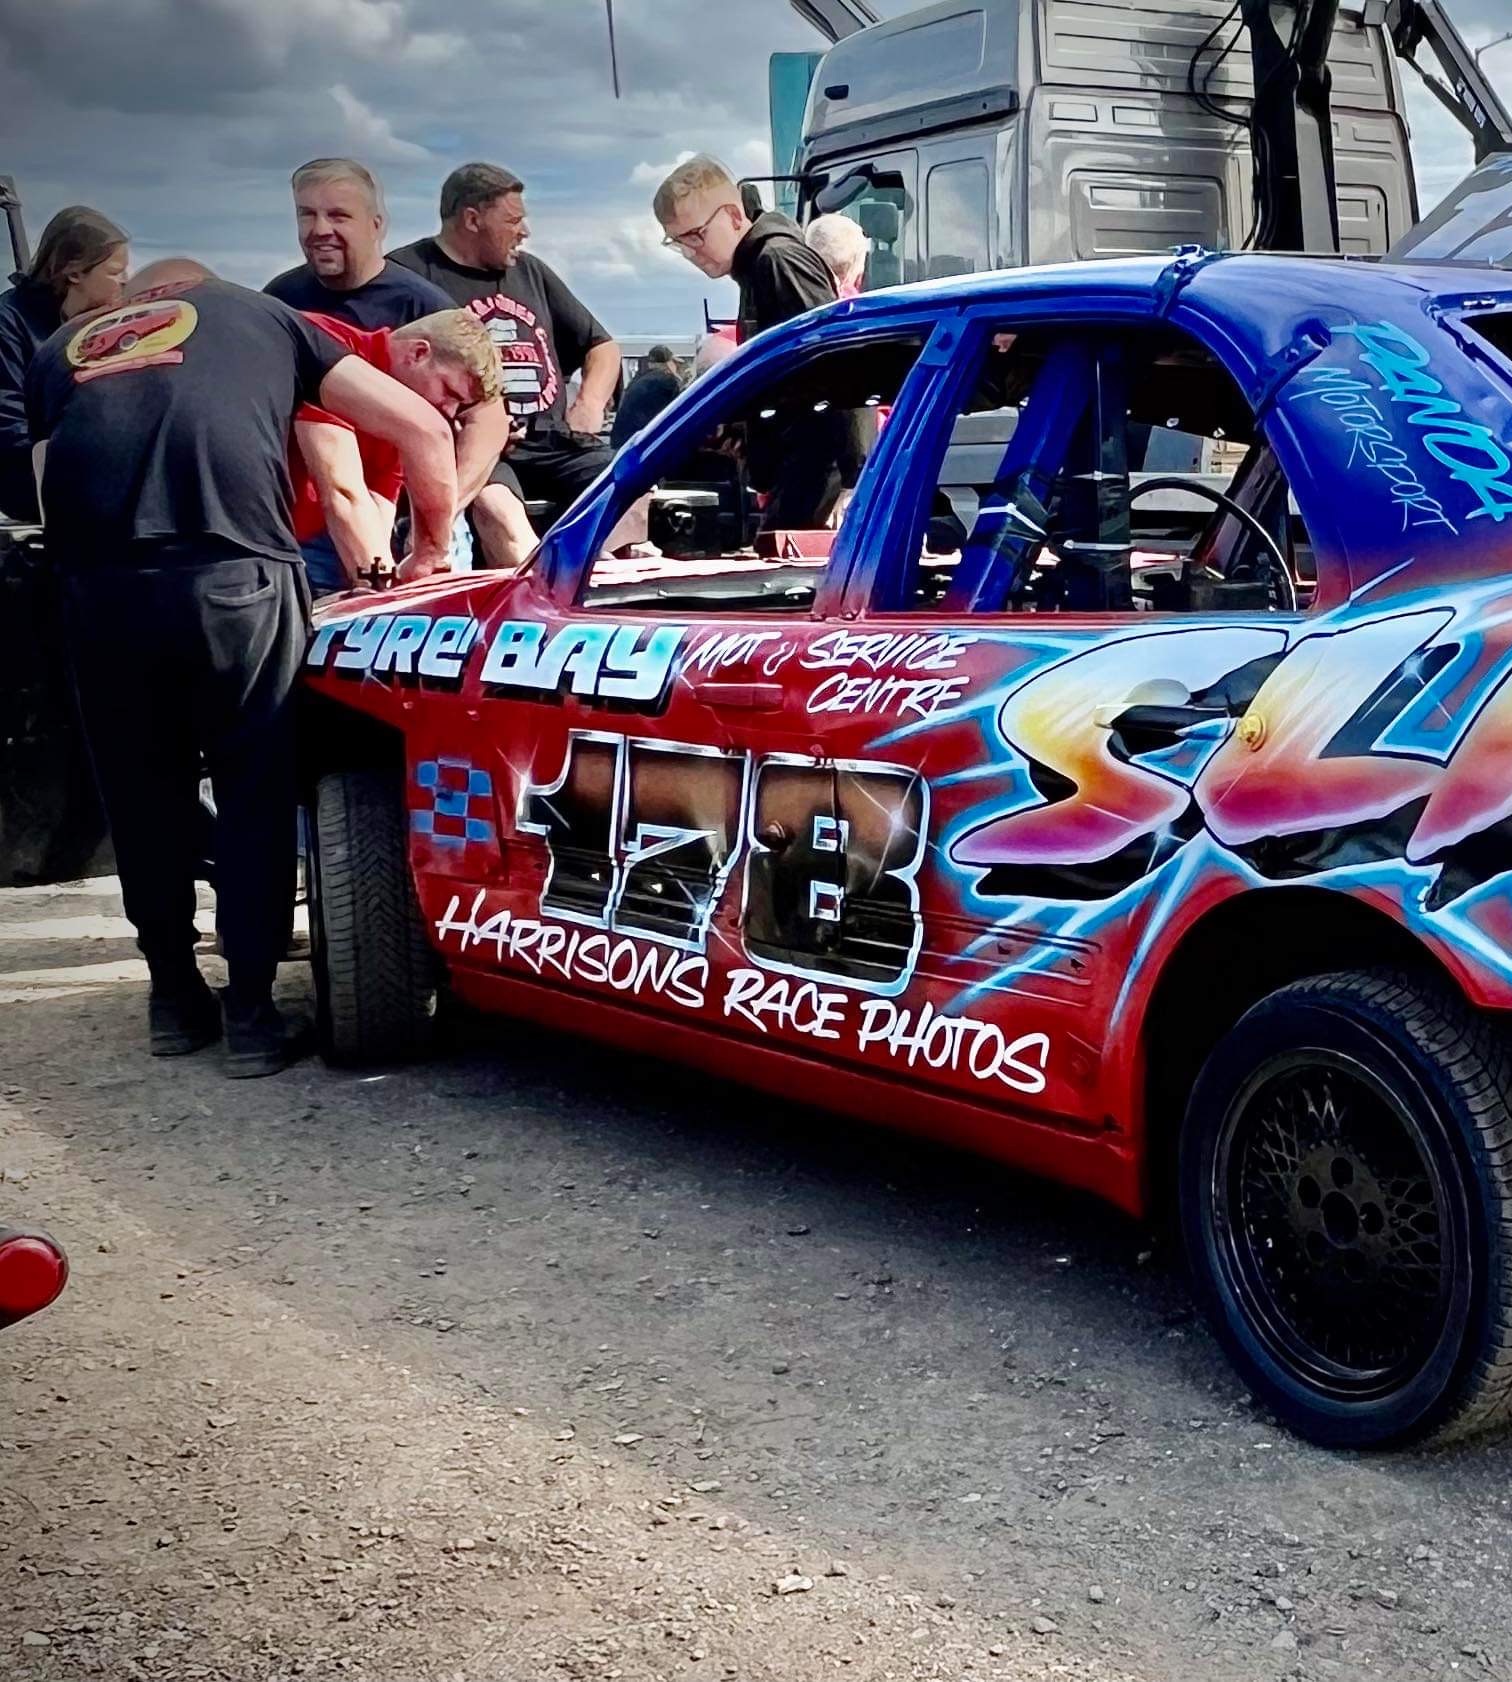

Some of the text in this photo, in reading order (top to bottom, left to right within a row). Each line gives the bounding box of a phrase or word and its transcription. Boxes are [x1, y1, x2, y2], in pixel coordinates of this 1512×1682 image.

[480, 619, 690, 702] BAY
[680, 631, 782, 677] MOT
[799, 629, 980, 672] SERVICE
[806, 672, 970, 717] CENTRE
[515, 727, 931, 997] 178
[434, 888, 1050, 1094] HARRISONS RACE PHOTOS
